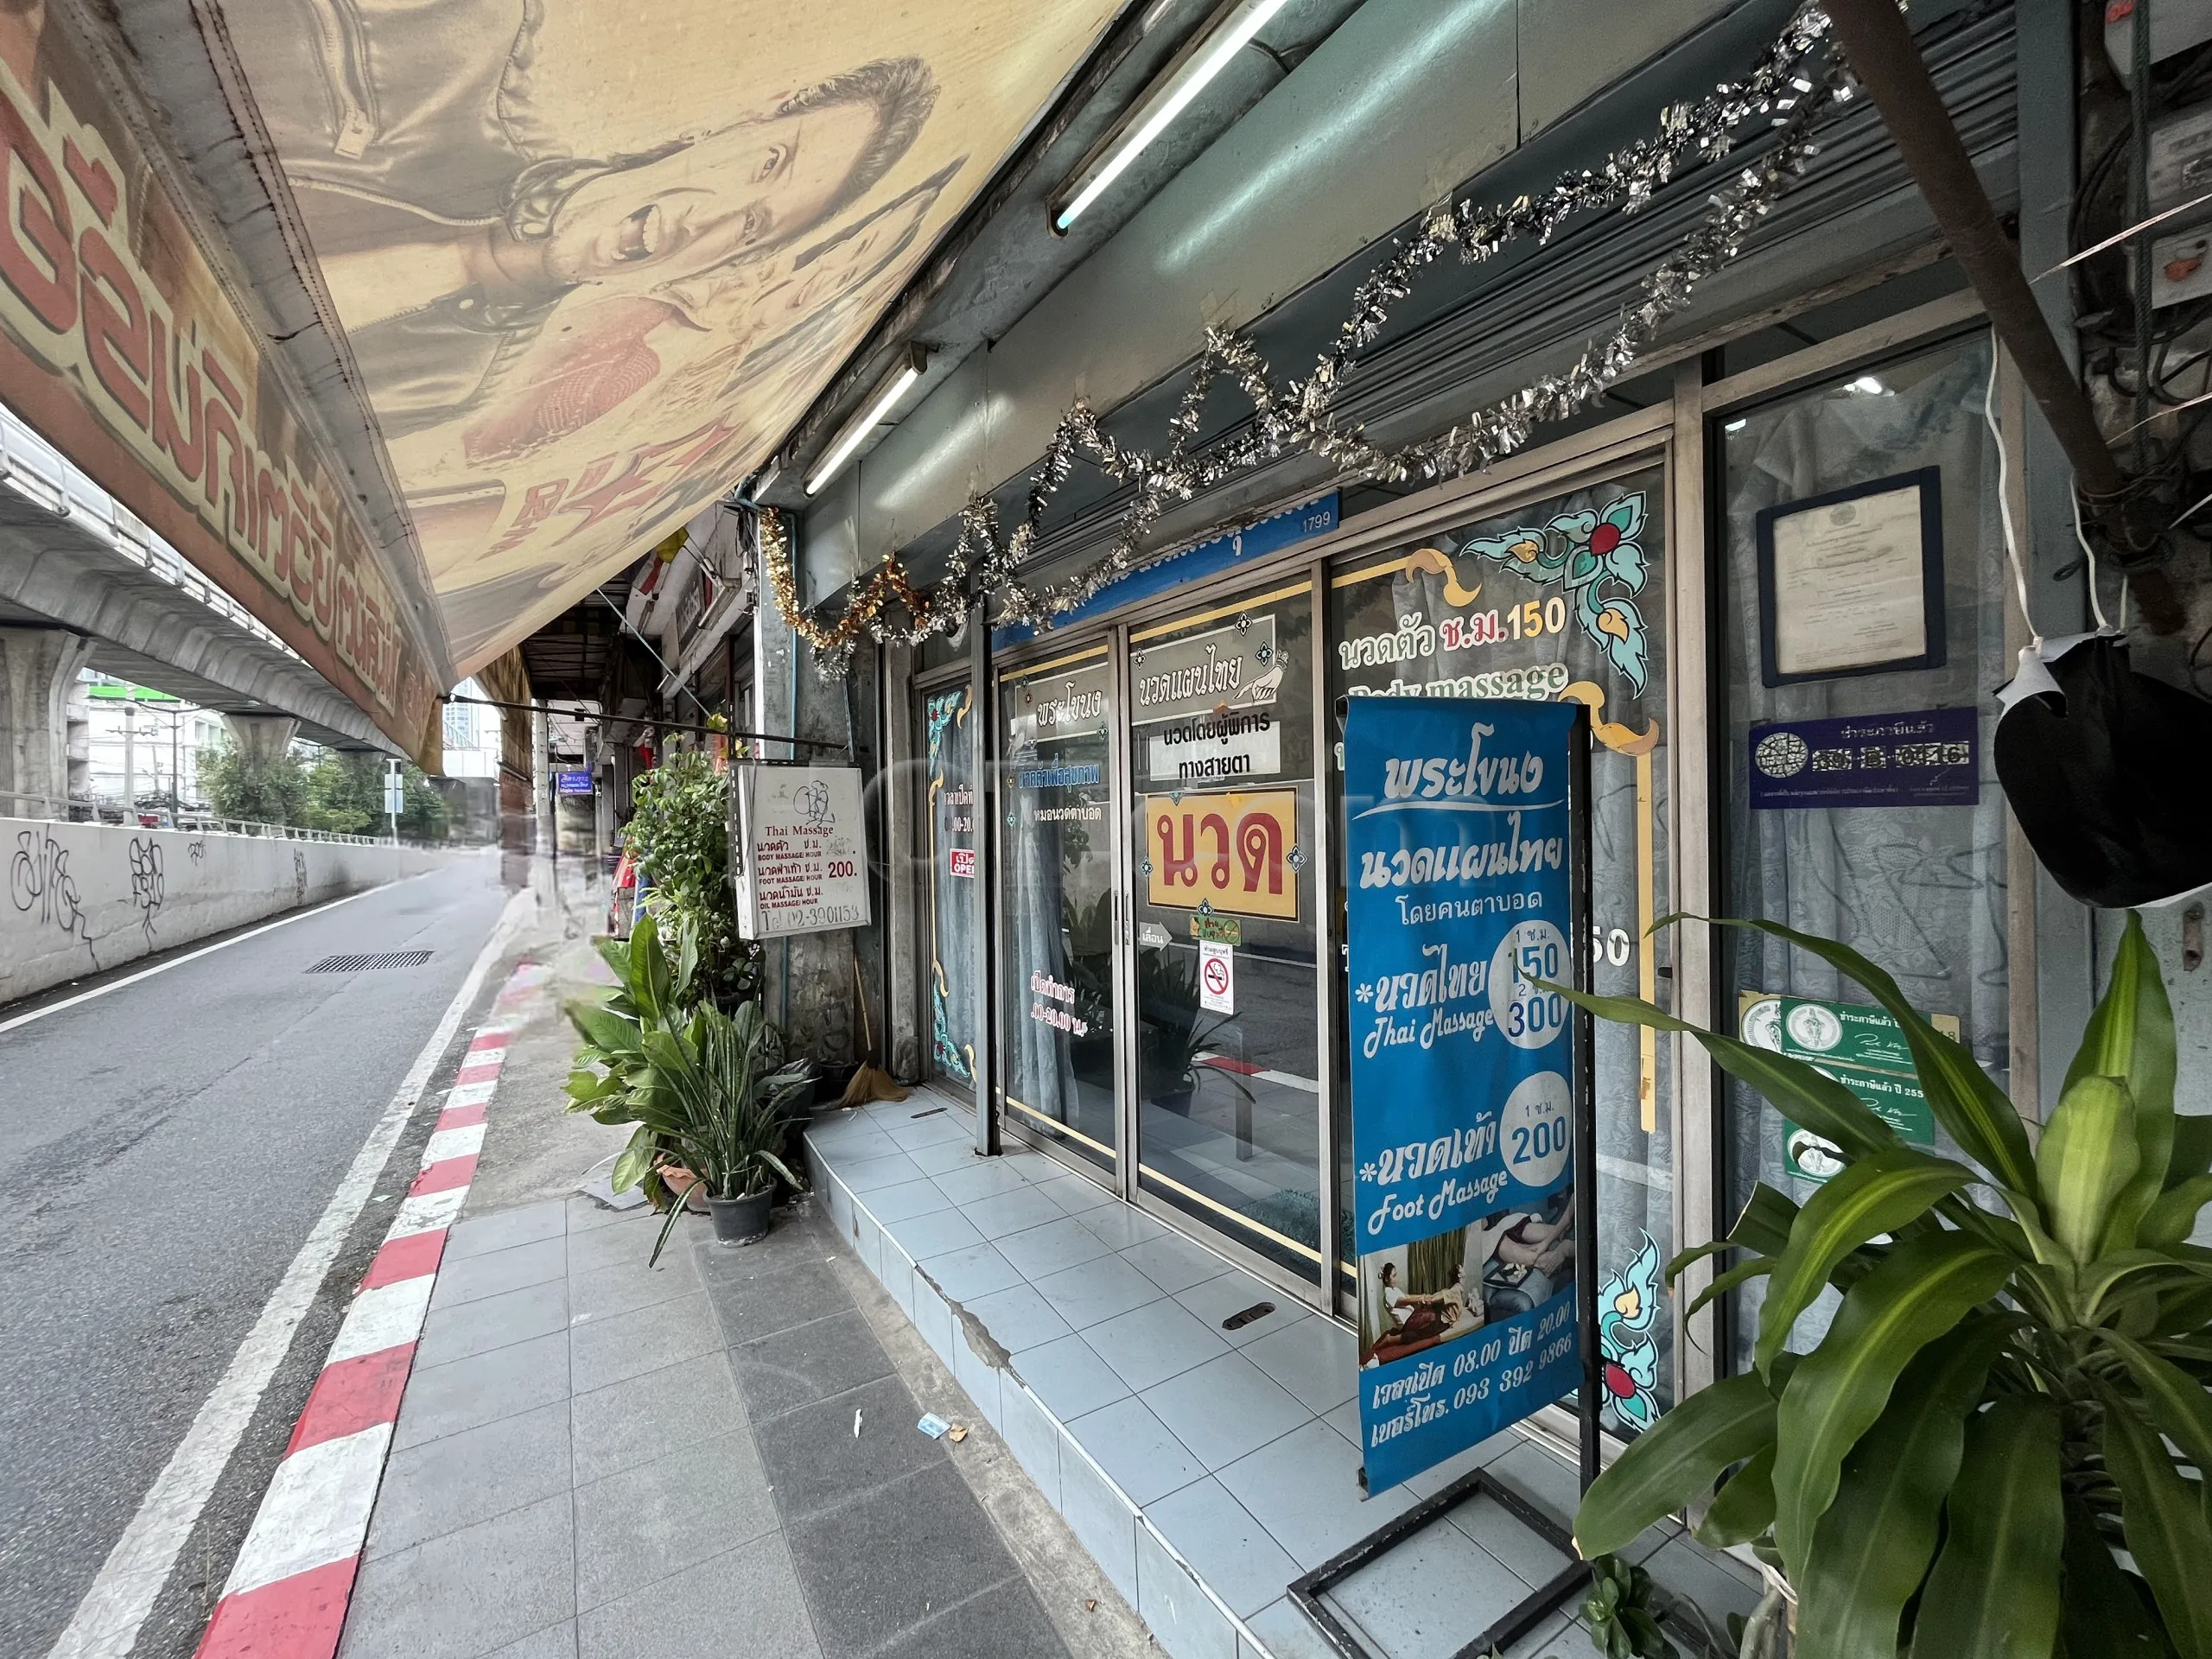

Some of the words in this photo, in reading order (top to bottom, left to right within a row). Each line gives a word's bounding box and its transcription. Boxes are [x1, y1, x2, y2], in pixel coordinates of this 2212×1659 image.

[1302, 511, 1332, 533] 1799
[1338, 612, 1435, 670] นวดตัว
[1139, 643, 1243, 706] นวดแผนไทย
[1037, 680, 1103, 727] พระโขนง
[1163, 711, 1271, 746] นวดโดยผู้พิการ
[1179, 753, 1250, 779] ทางสายตา
[1383, 722, 1545, 799] พระโขนง
[757, 839, 789, 852] นวดตัว
[766, 826, 788, 836] Thai
[792, 825, 834, 837] Massage
[1156, 811, 1284, 895] นวด
[1360, 810, 1564, 889] นวดแผนไทย
[1395, 890, 1543, 926] โดยคนตาบอด
[1142, 926, 1164, 944] เลื่อน
[1508, 943, 1559, 983] 150
[1363, 1016, 1415, 1059] Thai
[1420, 1007, 1495, 1051] Massage
[1508, 993, 1562, 1037] 300
[1904, 1088, 1924, 1098] 255
[1511, 1117, 1567, 1165] 200
[1368, 1192, 1424, 1235] Foot
[1428, 1170, 1508, 1222] Massage
[1372, 1362, 1446, 1410] เวลาเปิด
[1452, 1339, 1501, 1377] 08.00
[1508, 1326, 1533, 1356] ปิด
[1536, 1300, 1571, 1342] 20.00
[1453, 1377, 1491, 1410] 093
[1499, 1360, 1534, 1393] 392
[1538, 1332, 1573, 1370] 9866
